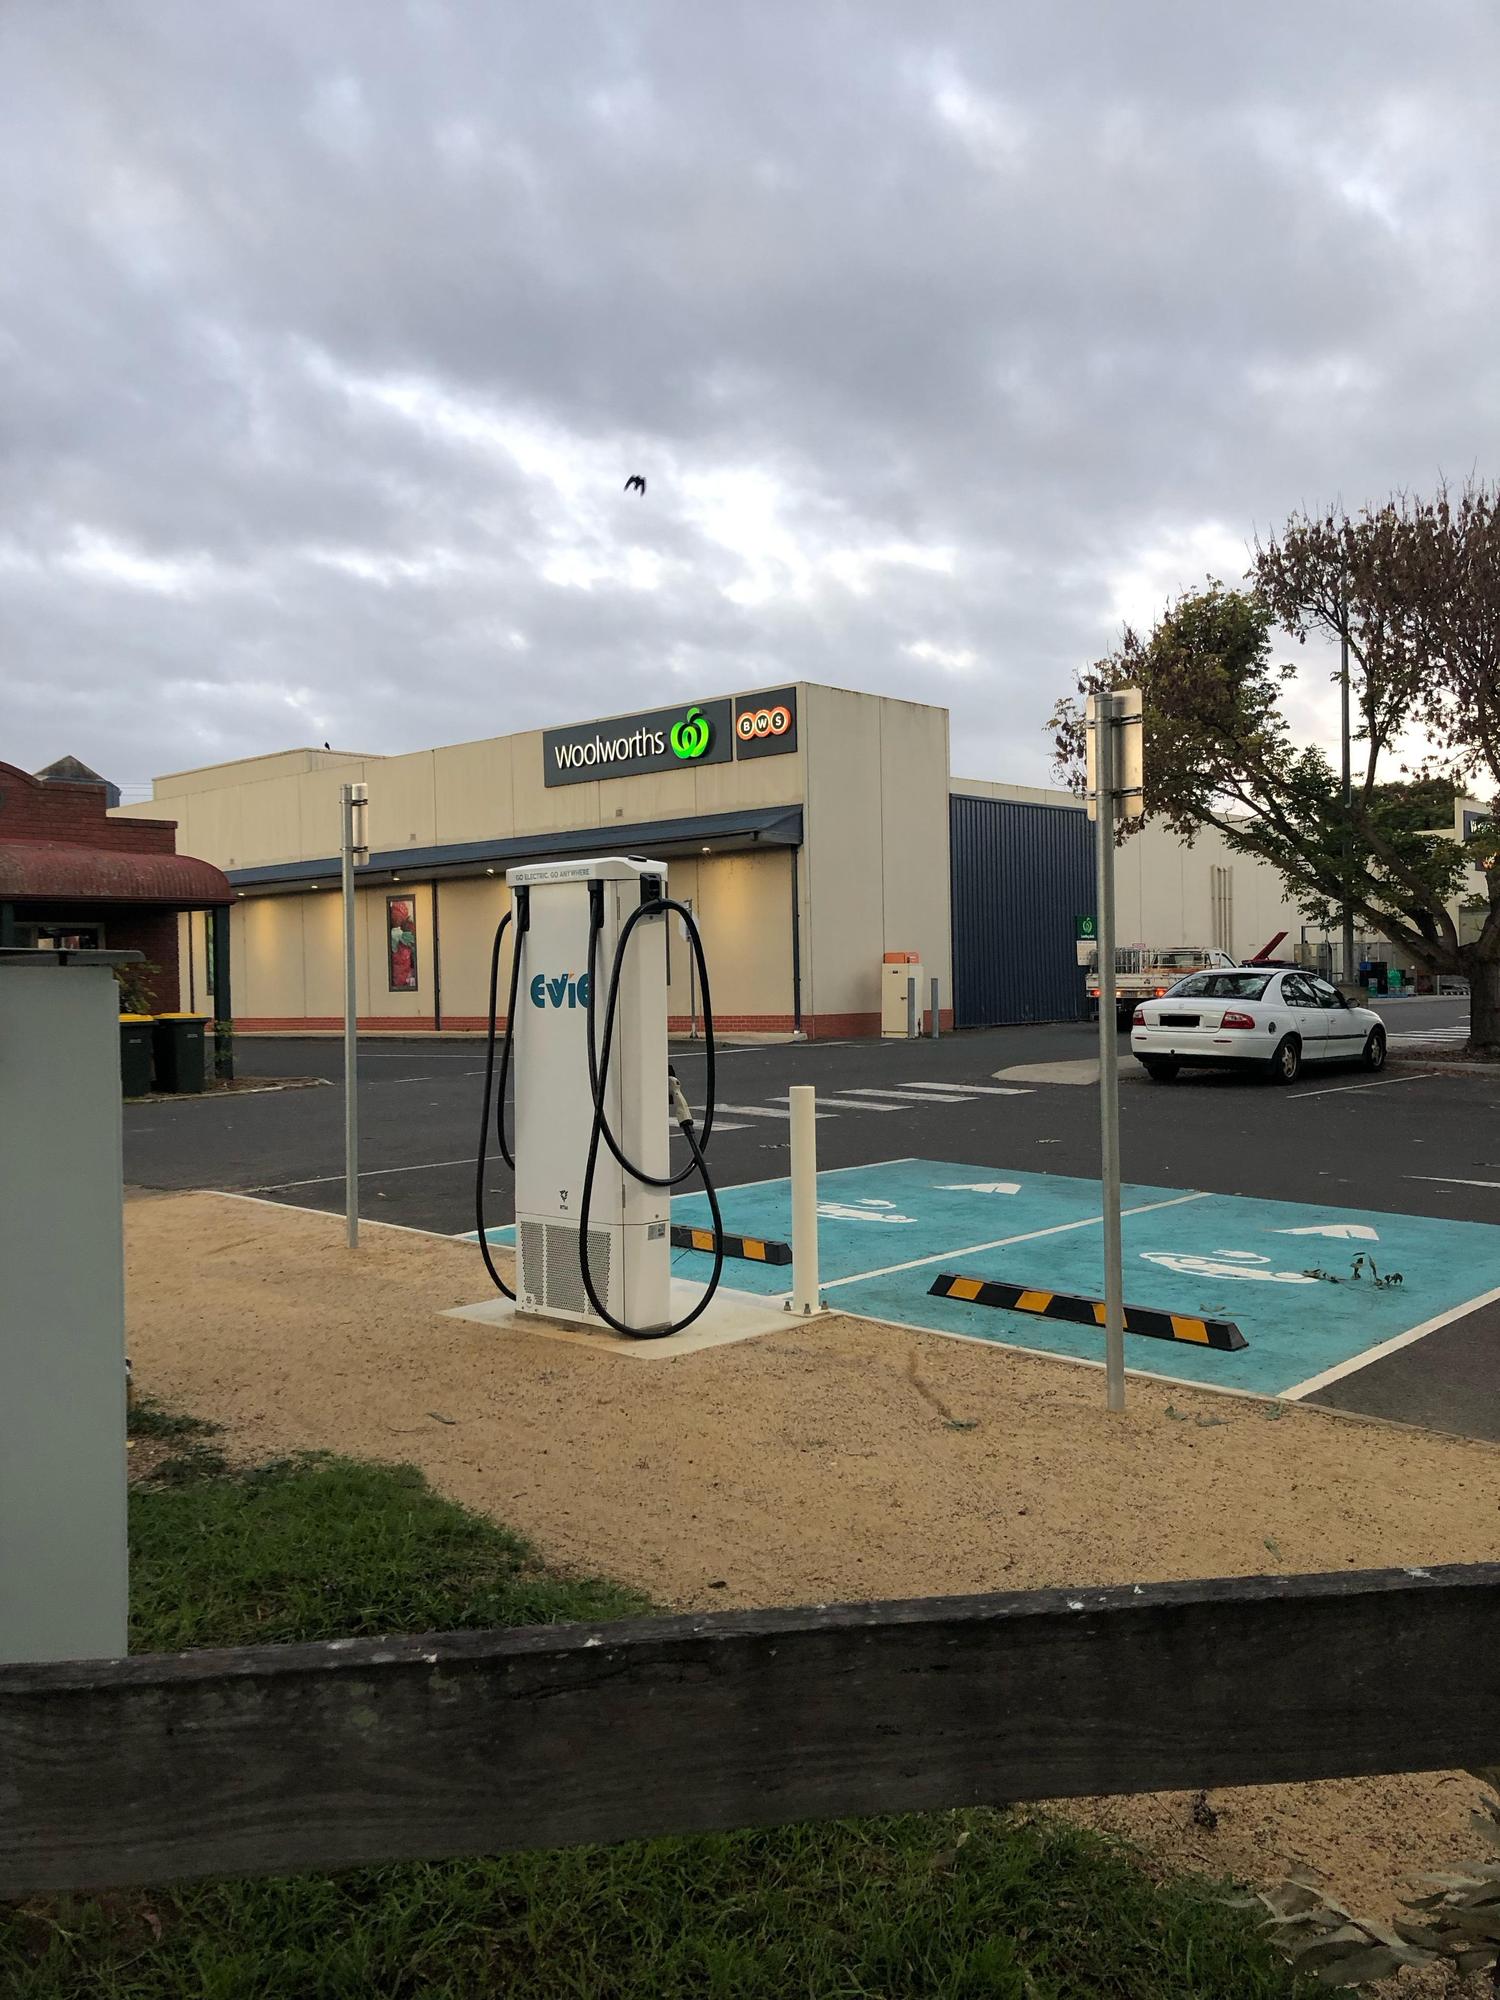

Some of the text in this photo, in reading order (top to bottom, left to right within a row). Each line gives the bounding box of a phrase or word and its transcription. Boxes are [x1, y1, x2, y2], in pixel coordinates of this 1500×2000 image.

[555, 727, 665, 769] Woolworths
[550, 871, 559, 879] GO
[560, 868, 590, 878] ANYWHERE
